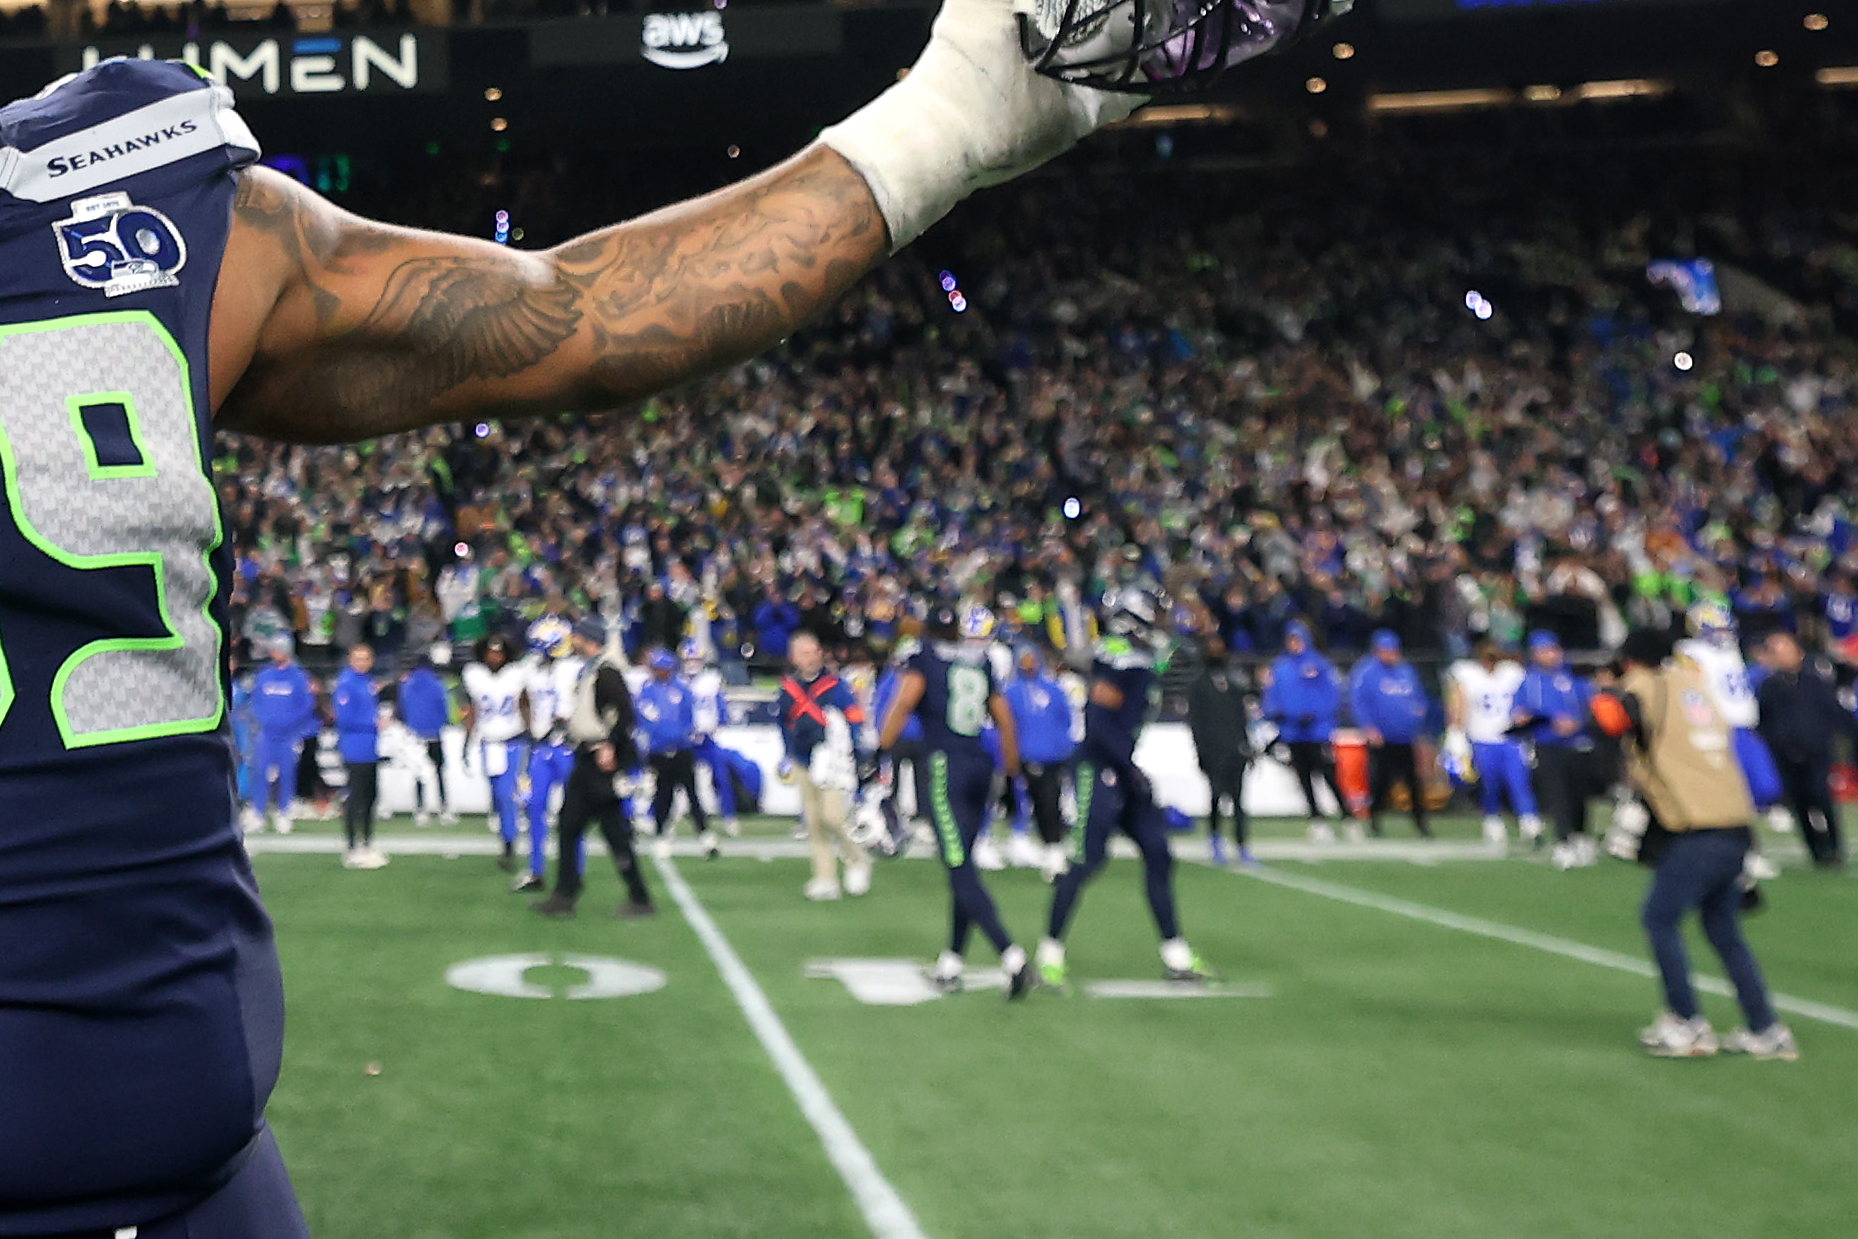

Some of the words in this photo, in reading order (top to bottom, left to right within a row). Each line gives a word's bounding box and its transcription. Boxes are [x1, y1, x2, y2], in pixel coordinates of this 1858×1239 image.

[643, 12, 724, 47] aws
[83, 32, 417, 94] MEN
[46, 119, 198, 179] SEAHAWKS
[53, 206, 186, 288] 50
[946, 662, 989, 737] 8
